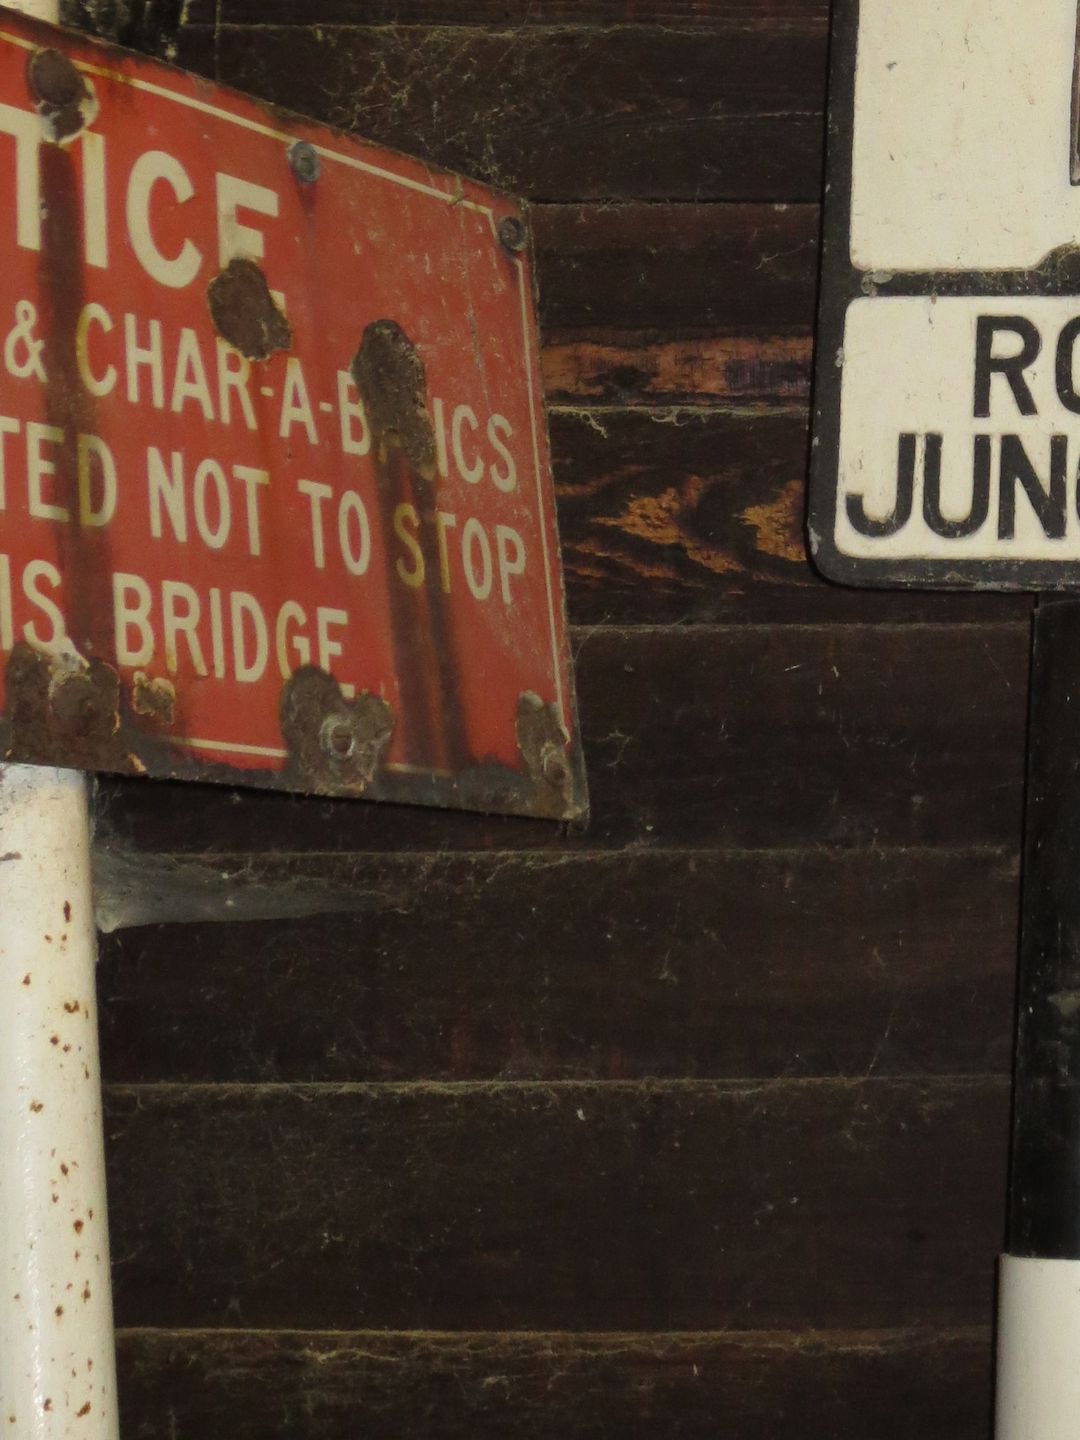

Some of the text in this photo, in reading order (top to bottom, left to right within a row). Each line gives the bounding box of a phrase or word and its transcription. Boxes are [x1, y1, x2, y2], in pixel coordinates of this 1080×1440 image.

[4, 299, 517, 494] & CHAR-A-BCS
[147, 446, 270, 557] NOT
[297, 478, 372, 577] TO
[393, 502, 527, 606] STOP
[111, 571, 356, 700] BRIDGE
